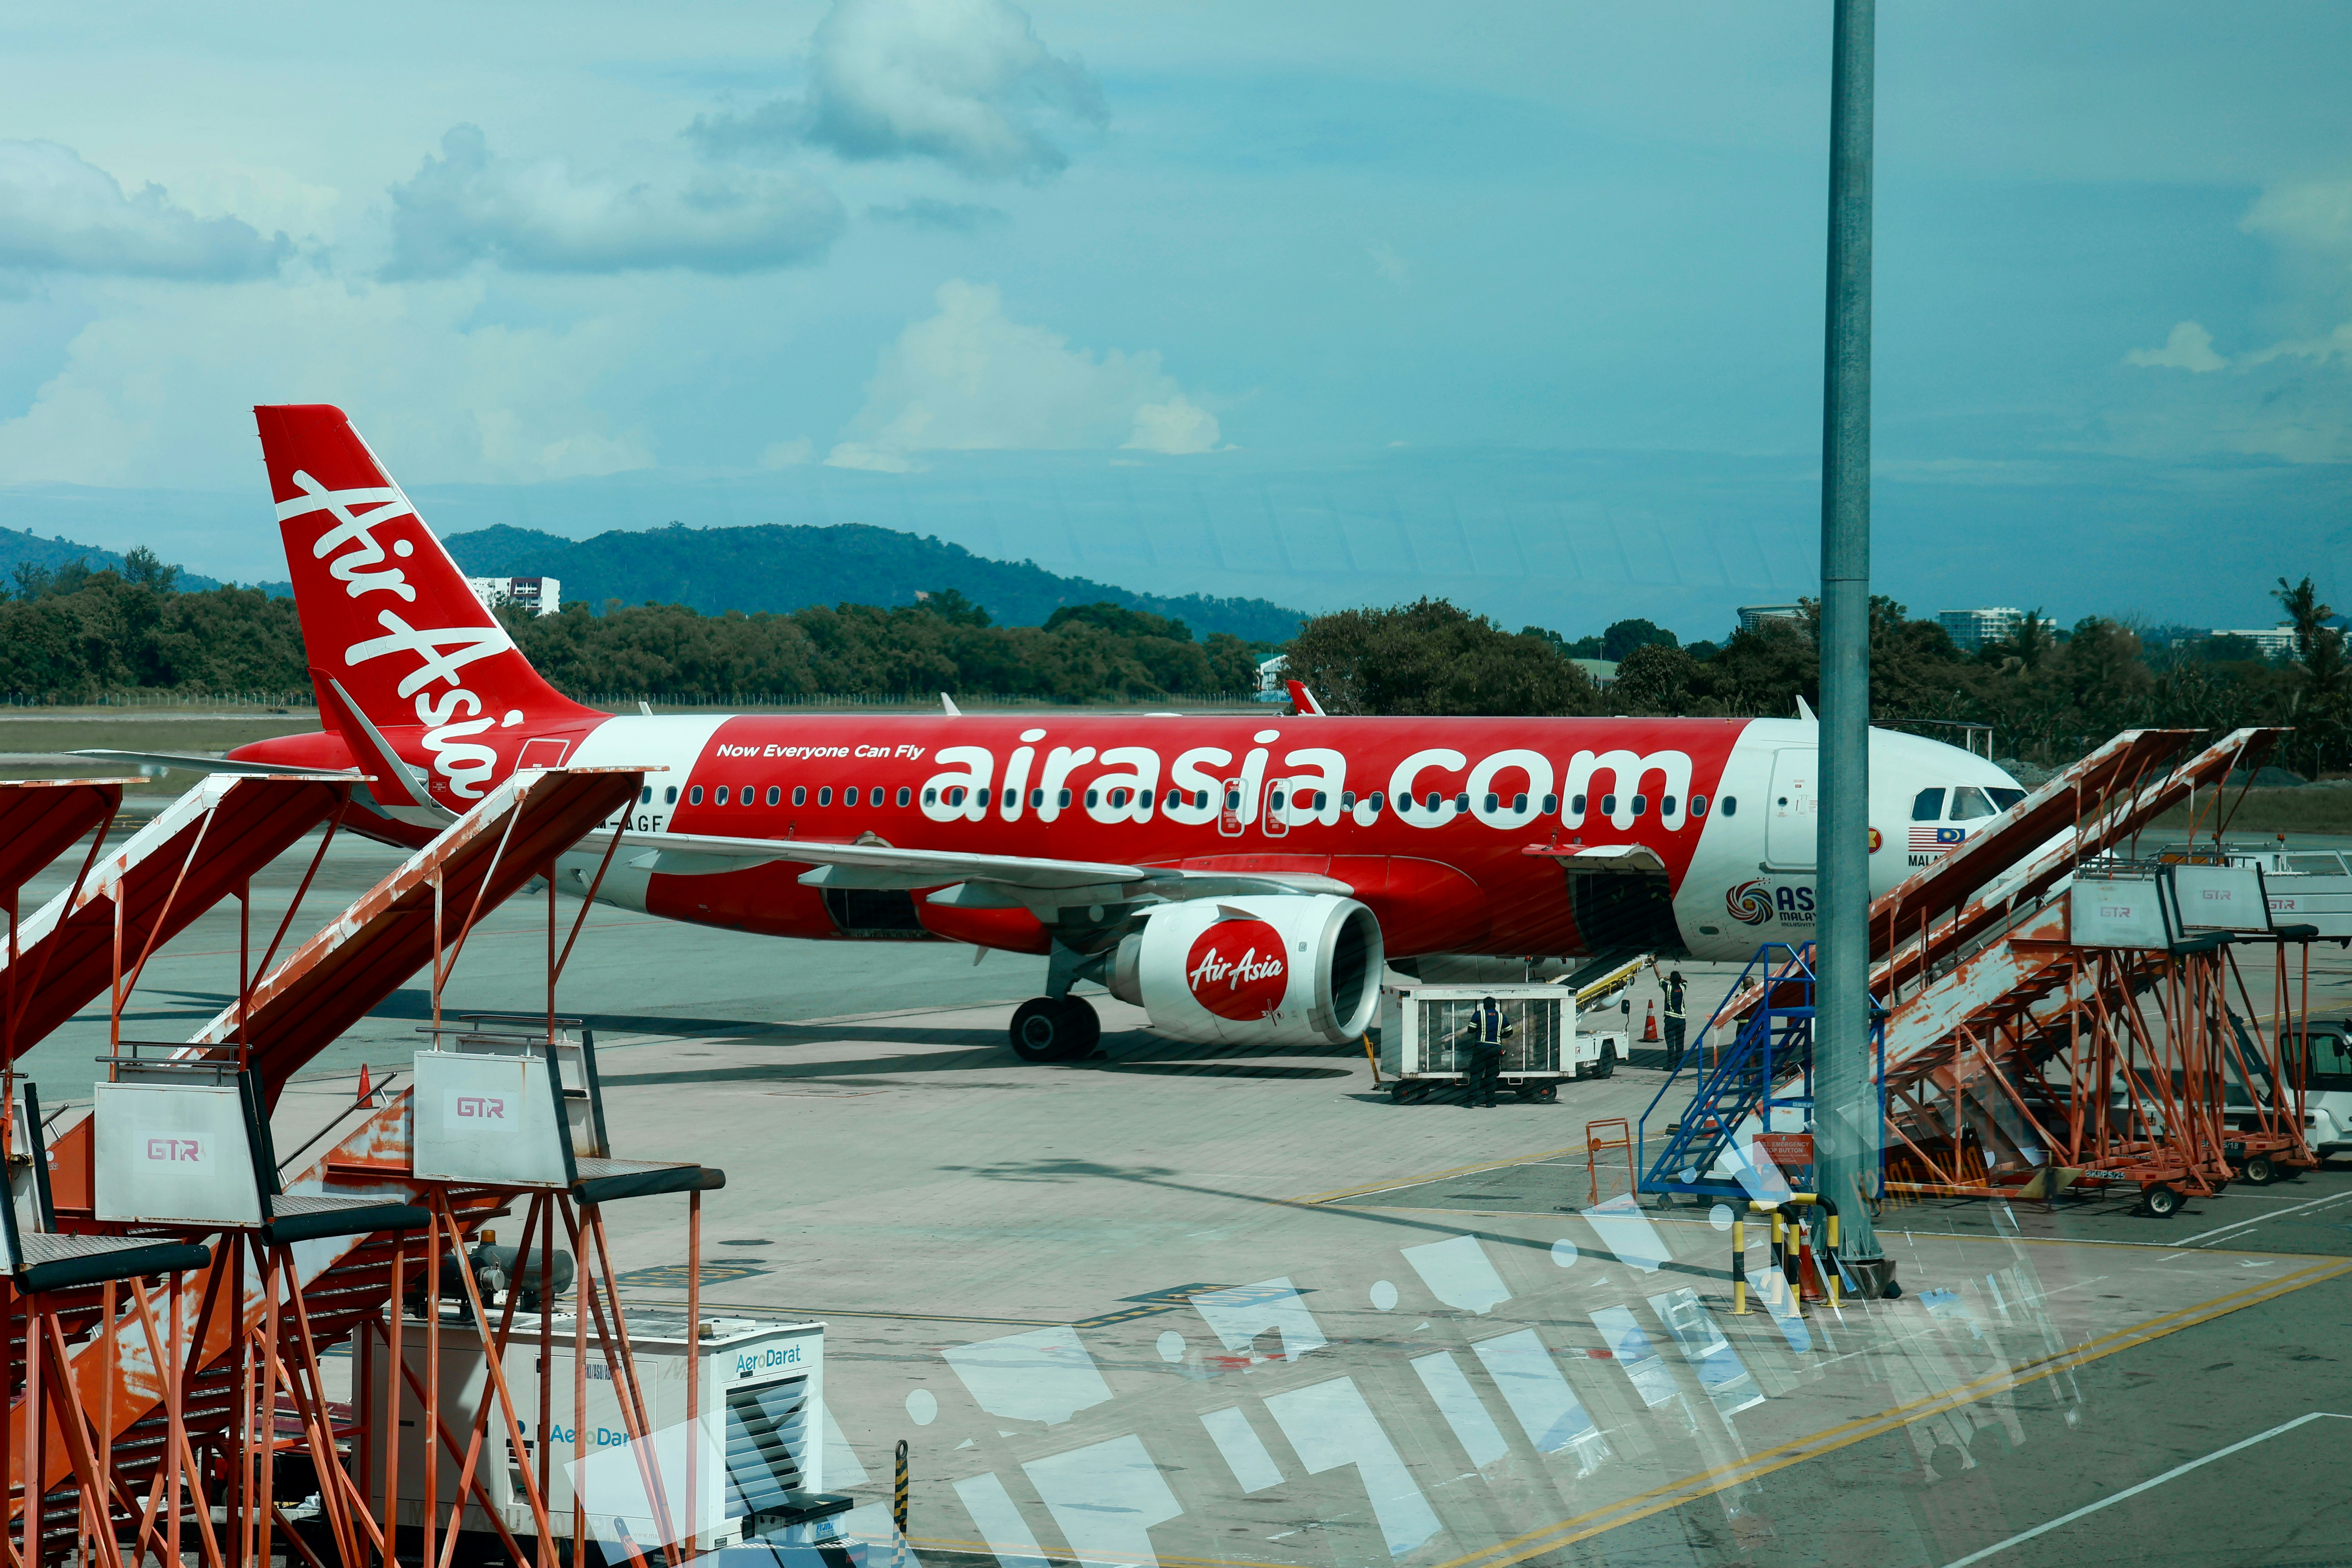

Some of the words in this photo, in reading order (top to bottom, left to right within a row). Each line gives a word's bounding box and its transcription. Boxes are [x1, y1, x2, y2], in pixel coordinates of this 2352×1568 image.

[717, 744, 760, 757] Now
[763, 744, 849, 760] Everyone
[854, 745, 890, 758] Can
[895, 744, 925, 760] Fly
[920, 728, 1692, 831] airasia.com
[2203, 889, 2231, 900] GTR
[2100, 906, 2131, 918] GTR
[2268, 900, 2295, 909] GTR
[457, 1097, 505, 1119] GTR
[147, 1138, 200, 1161] GTR
[736, 1344, 801, 1373] AeroDarat
